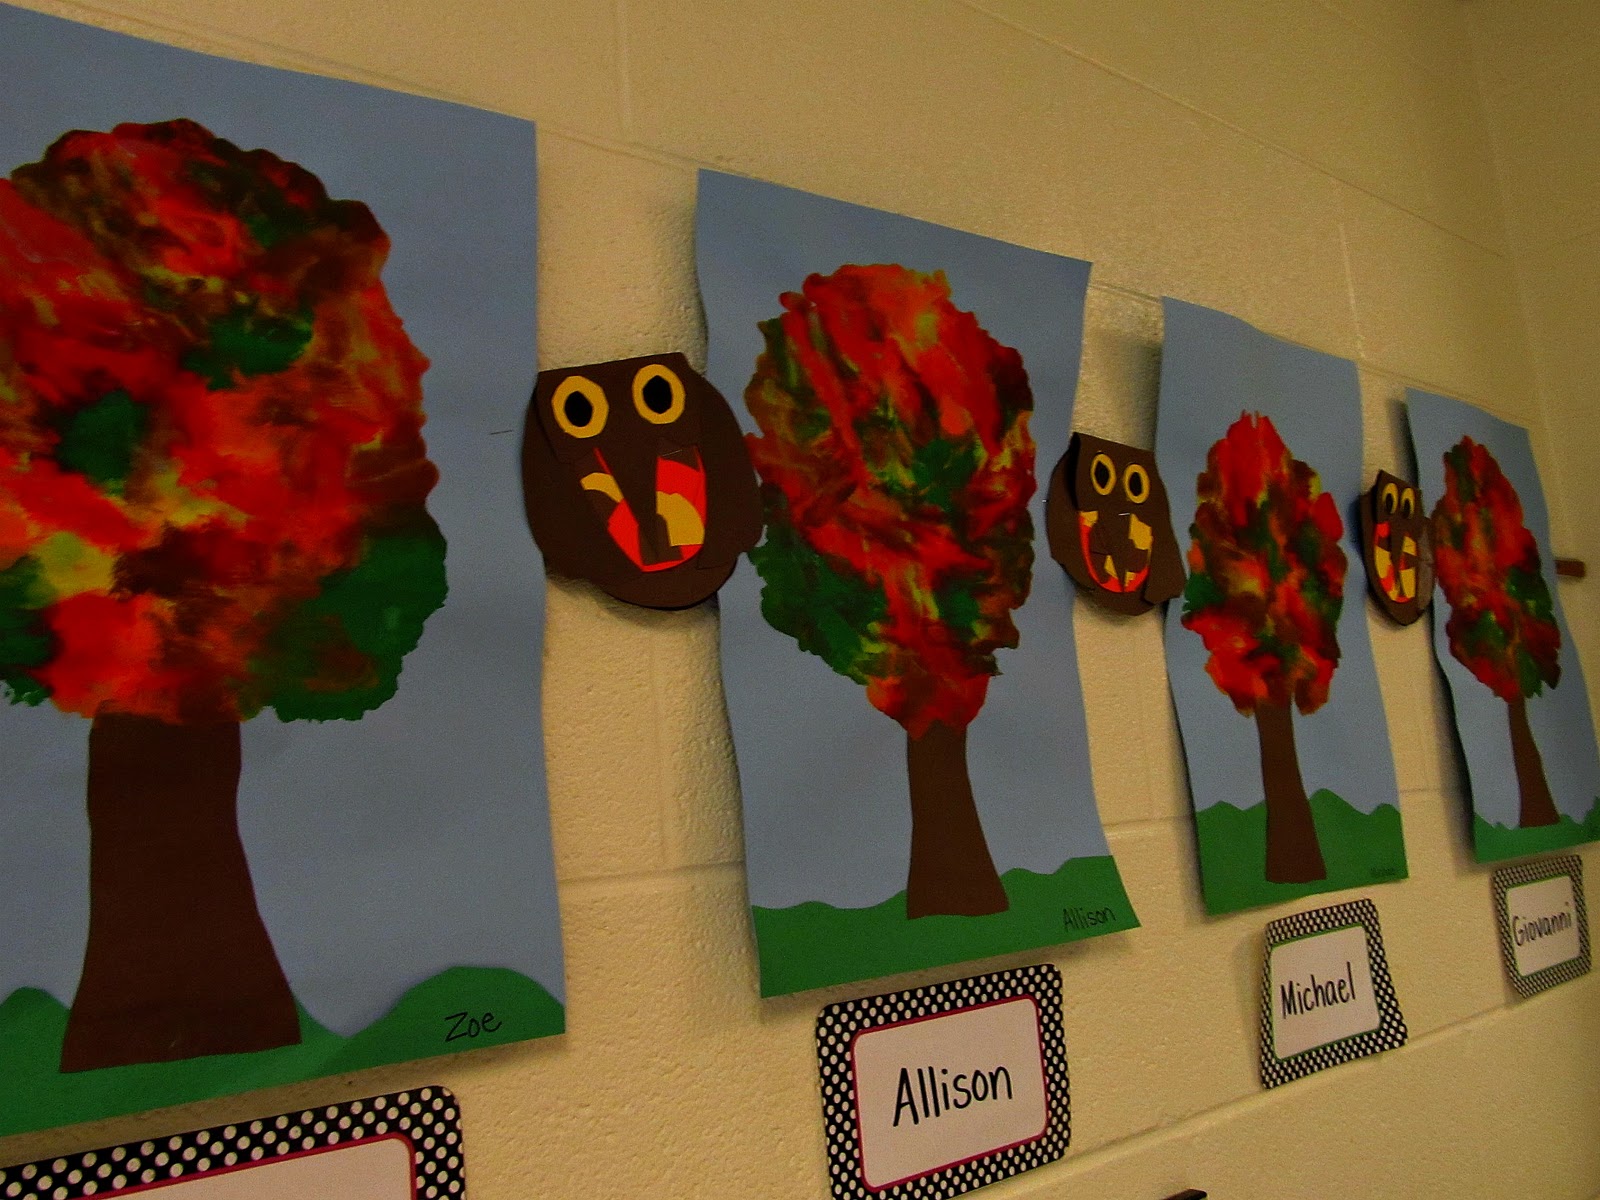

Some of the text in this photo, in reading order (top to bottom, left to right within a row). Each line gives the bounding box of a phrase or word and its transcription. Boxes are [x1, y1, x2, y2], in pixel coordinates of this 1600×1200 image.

[1062, 906, 1116, 933] Allison
[1512, 901, 1572, 947] Giovanni
[1280, 961, 1356, 1019] Michael
[443, 1011, 503, 1042] Zoe
[892, 1065, 1013, 1127] Allison
